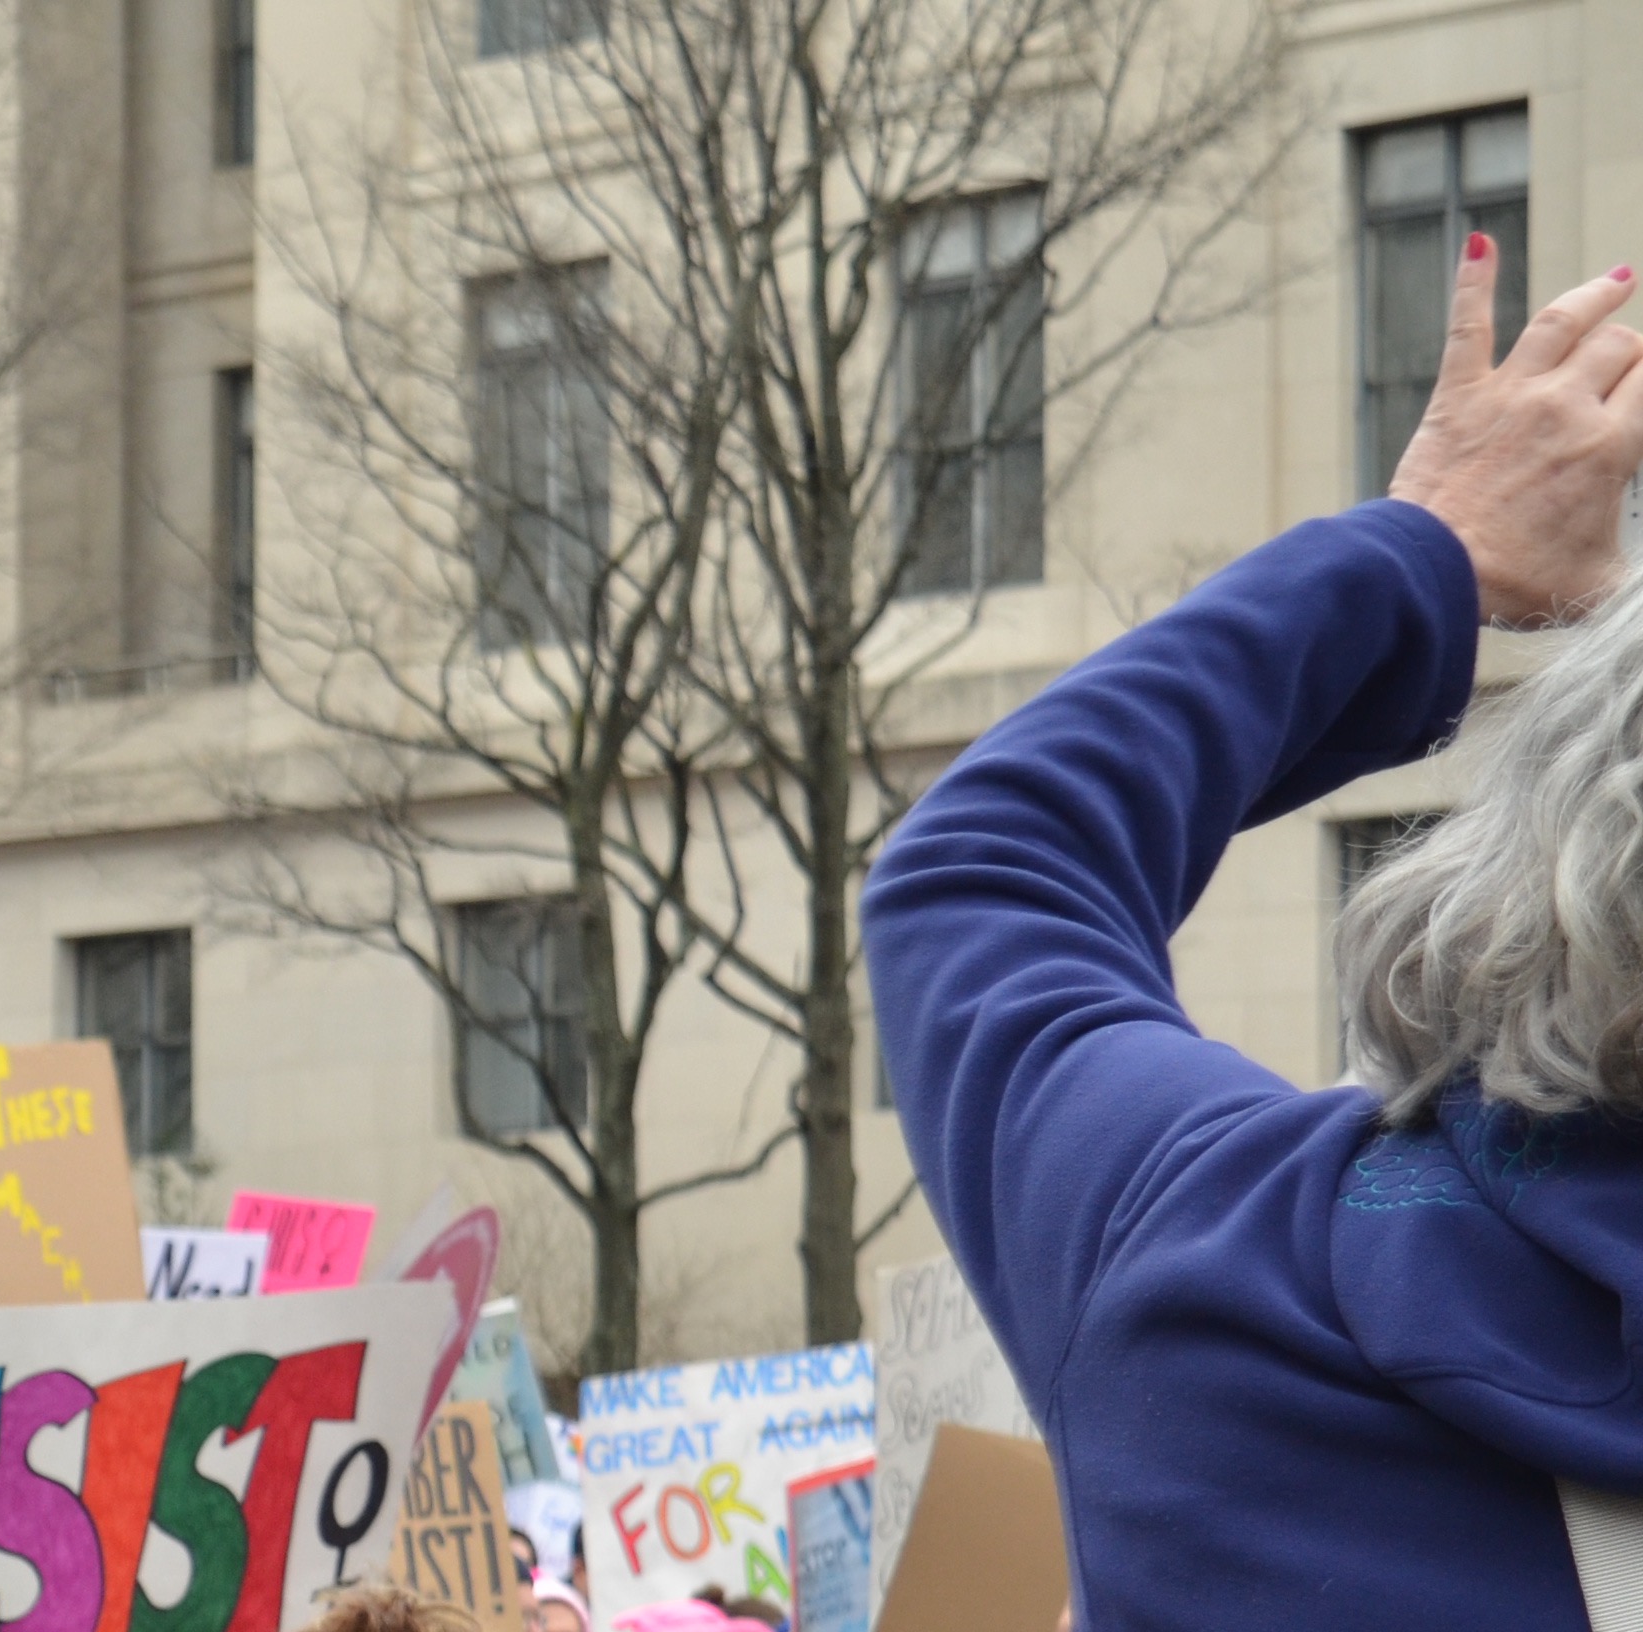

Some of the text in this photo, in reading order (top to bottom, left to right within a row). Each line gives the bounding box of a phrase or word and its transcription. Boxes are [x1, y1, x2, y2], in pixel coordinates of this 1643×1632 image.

[579, 1364, 685, 1419] MAKE
[711, 1342, 875, 1400] AMERICA
[403, 1416, 491, 1520] BER
[584, 1420, 721, 1476] GREAT
[758, 1401, 875, 1453] AGAIN
[611, 1461, 766, 1577] FOR
